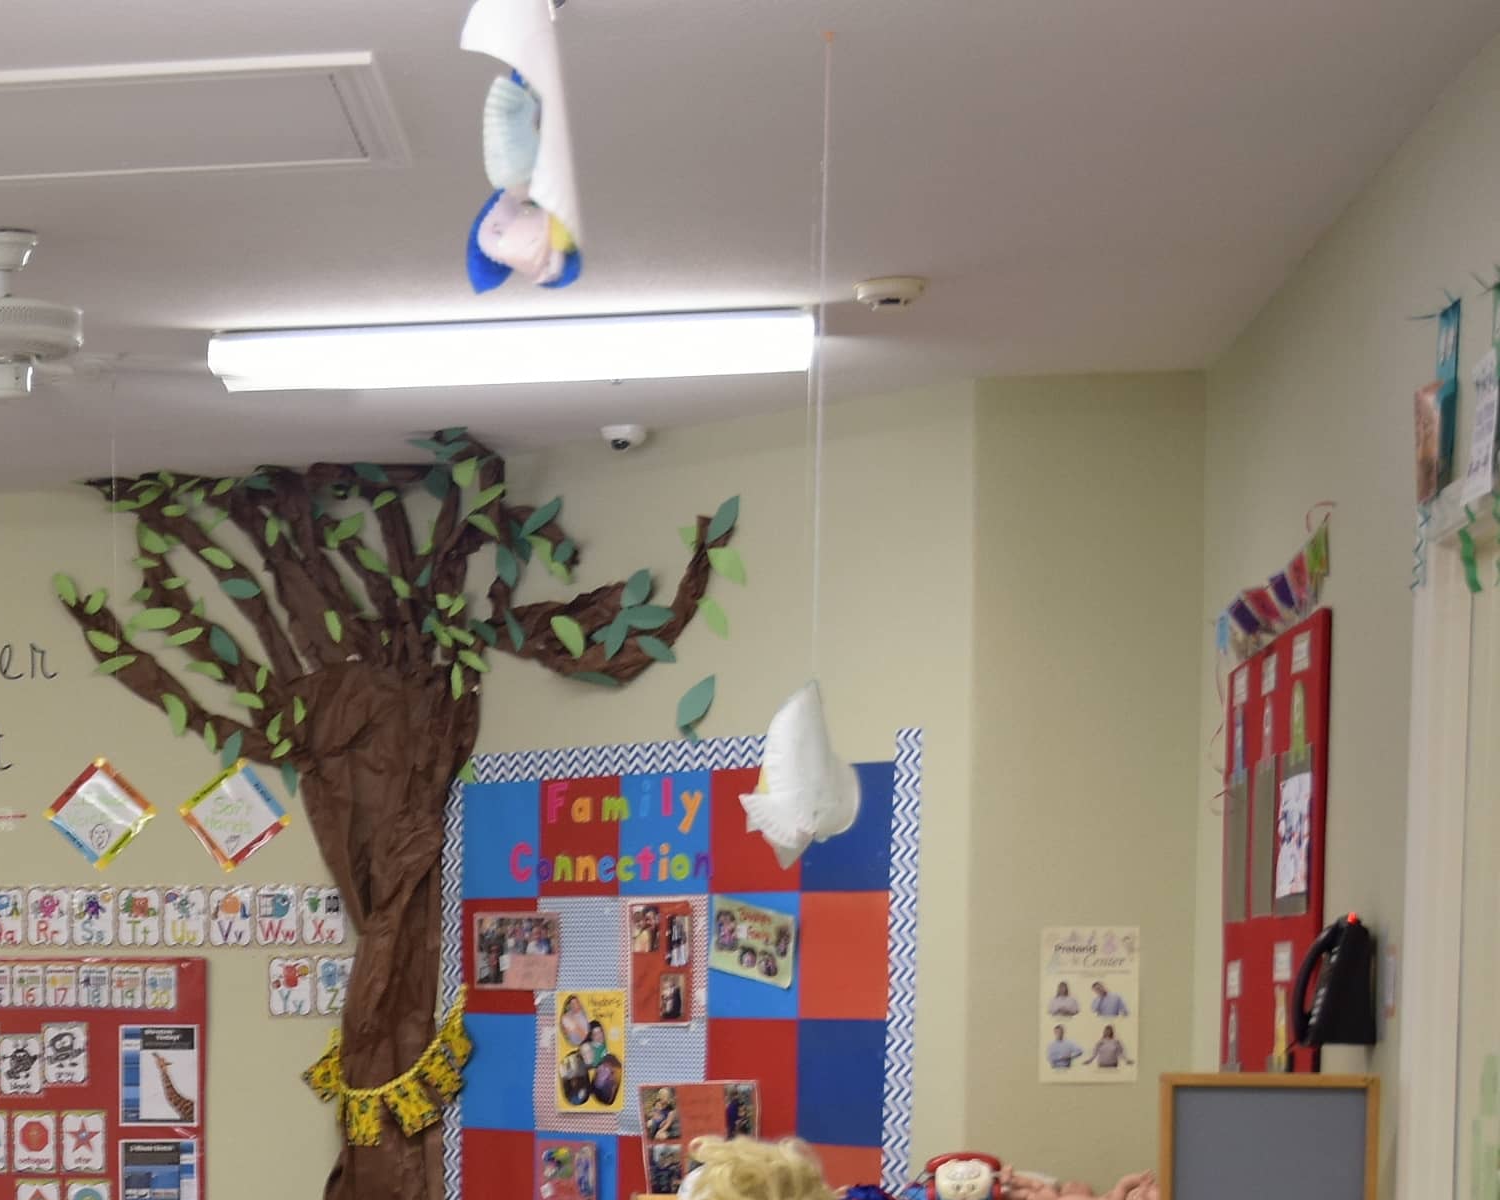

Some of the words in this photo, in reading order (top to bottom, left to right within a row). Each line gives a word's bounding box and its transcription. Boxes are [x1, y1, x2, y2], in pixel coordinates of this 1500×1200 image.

[546, 777, 704, 834] Family
[508, 842, 714, 885] Connection
[36, 920, 59, 942] Rr
[81, 920, 104, 941] Ss
[127, 920, 150, 940] Tt
[171, 920, 197, 942] Uu
[218, 920, 243, 940] Vv
[259, 920, 296, 941] Ww
[312, 919, 336, 940] Xx
[278, 989, 303, 1013] Yy
